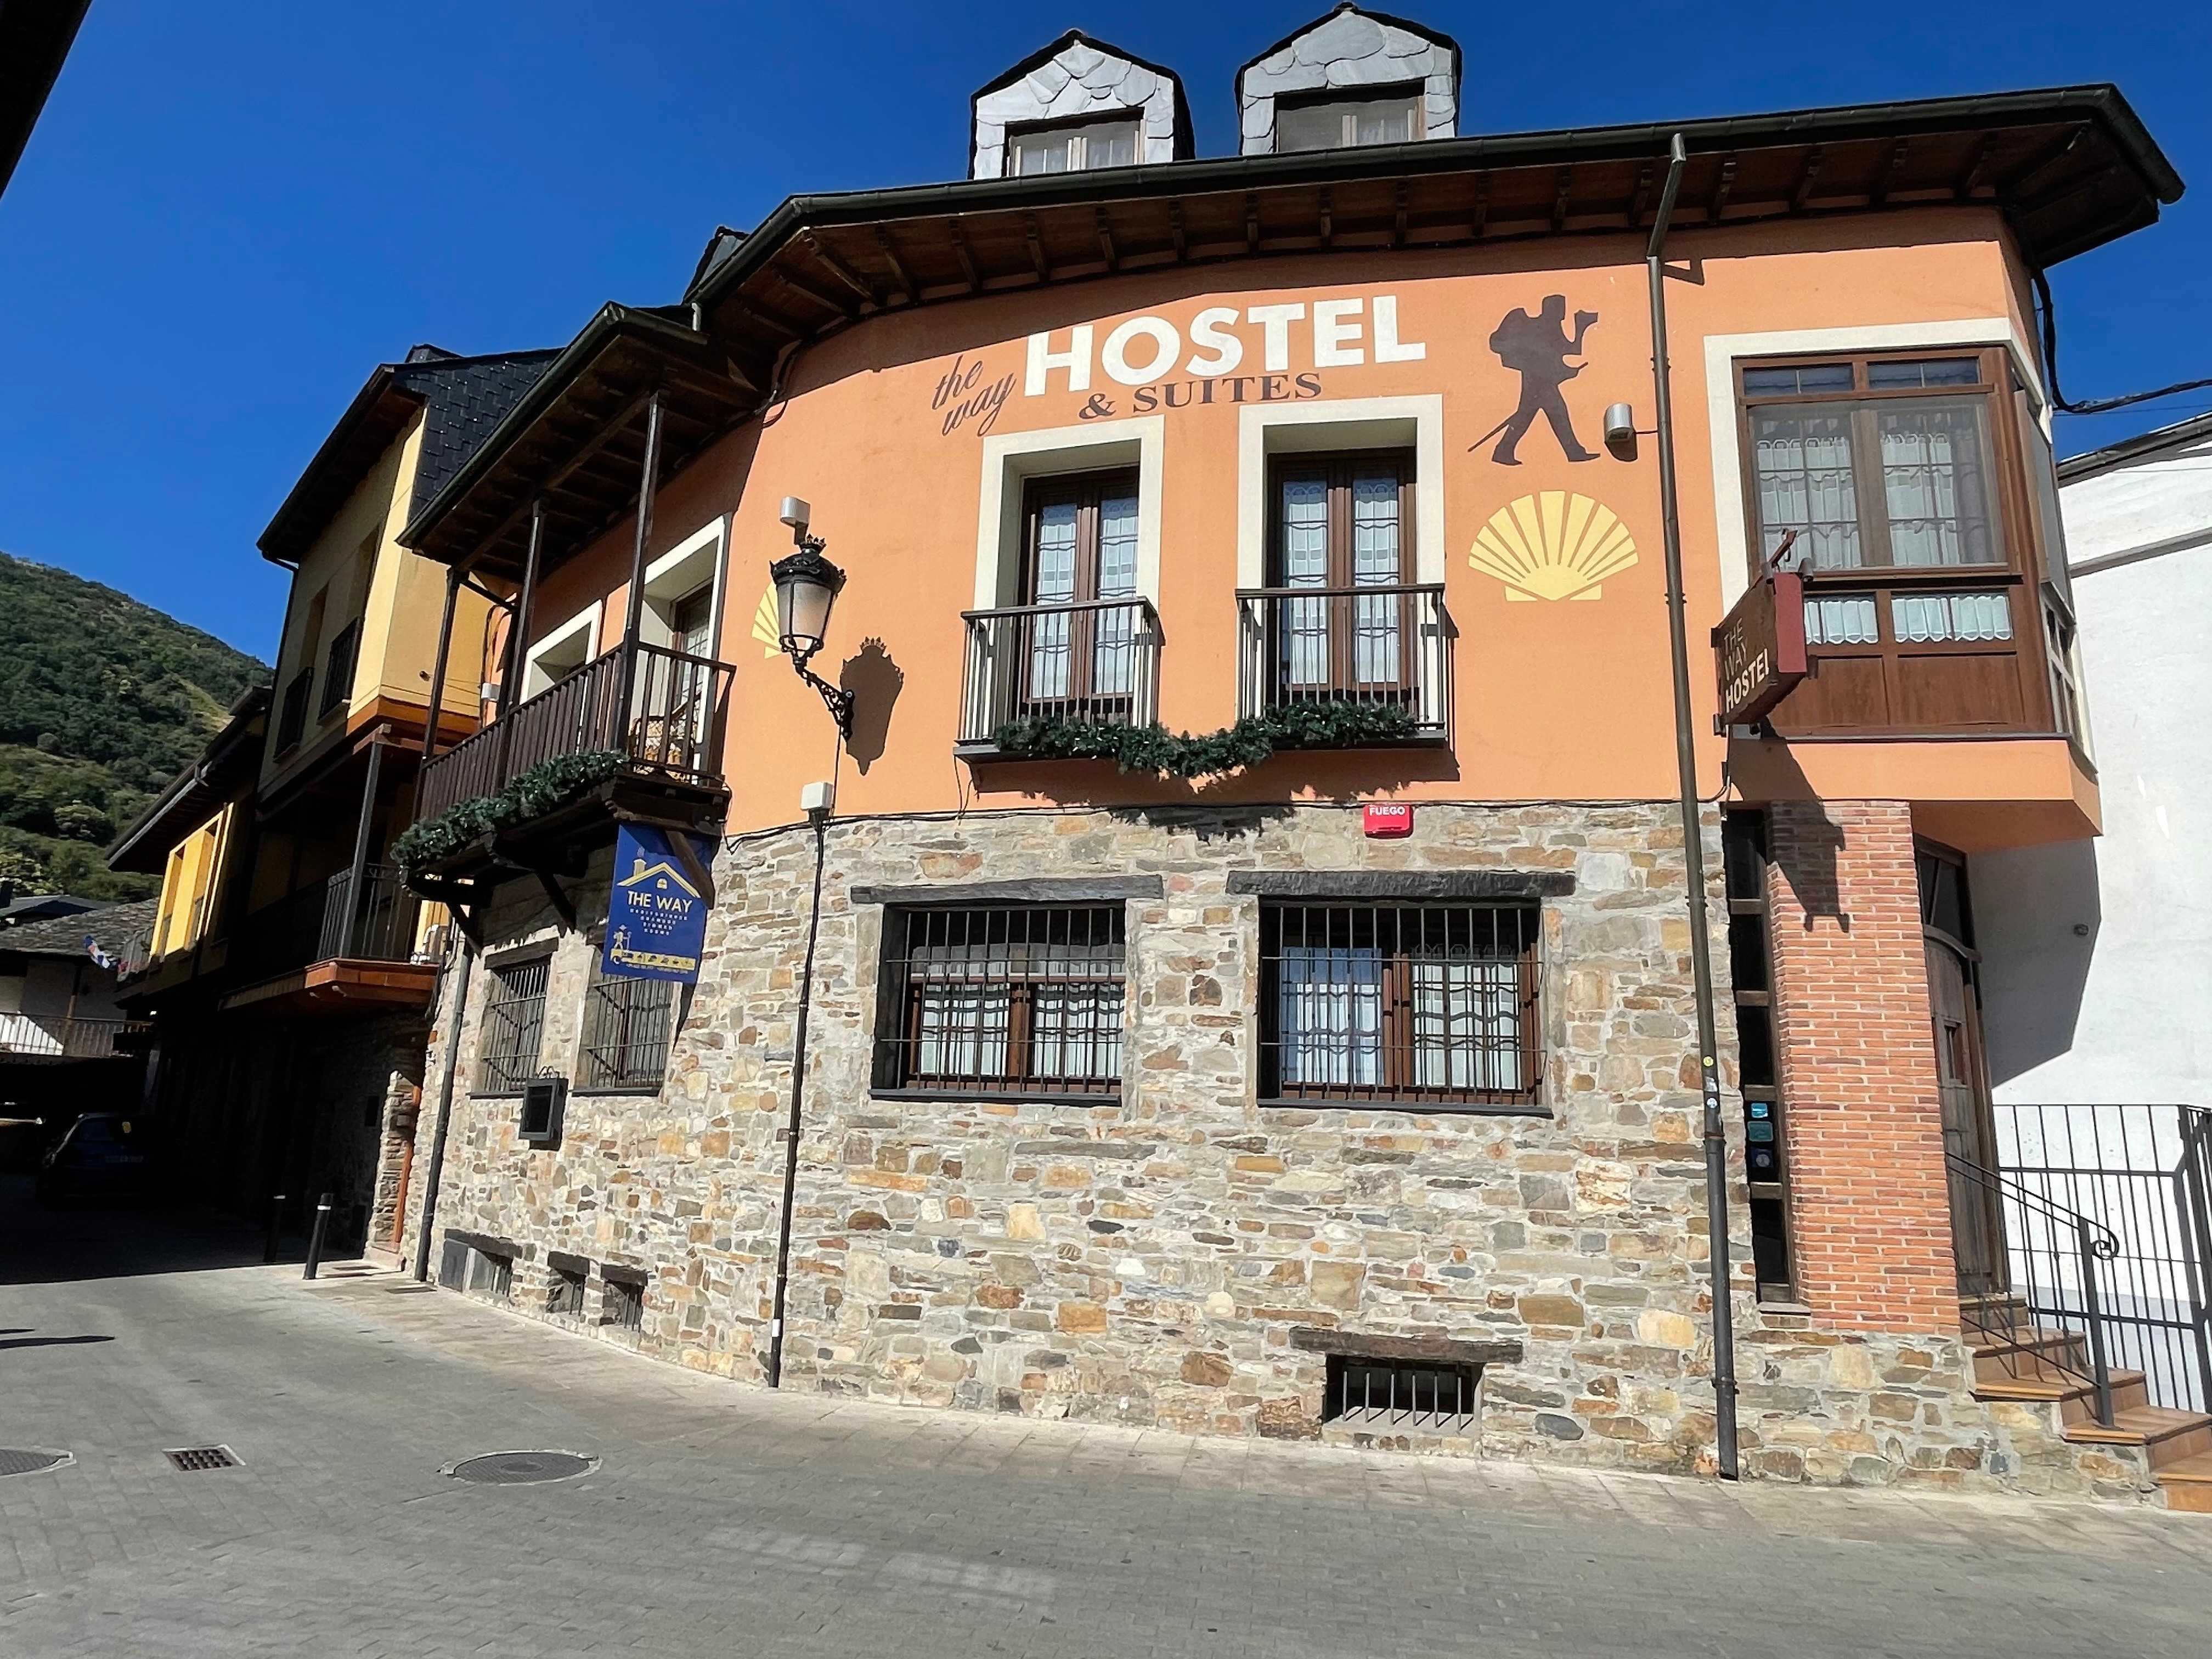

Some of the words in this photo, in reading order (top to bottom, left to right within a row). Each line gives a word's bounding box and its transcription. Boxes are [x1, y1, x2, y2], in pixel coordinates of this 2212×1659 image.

[1024, 295, 1426, 397] HOSTEL
[932, 354, 984, 410] the
[942, 372, 1017, 437] way
[1079, 393, 1116, 419] &
[1133, 372, 1322, 413] SUITES
[1724, 617, 1743, 656] THE
[1724, 636, 1748, 680] WAY
[1725, 647, 1770, 713] HOSTEL
[1369, 806, 1406, 816] FUEGO
[628, 891, 652, 907] THE
[657, 895, 692, 913] WAY
